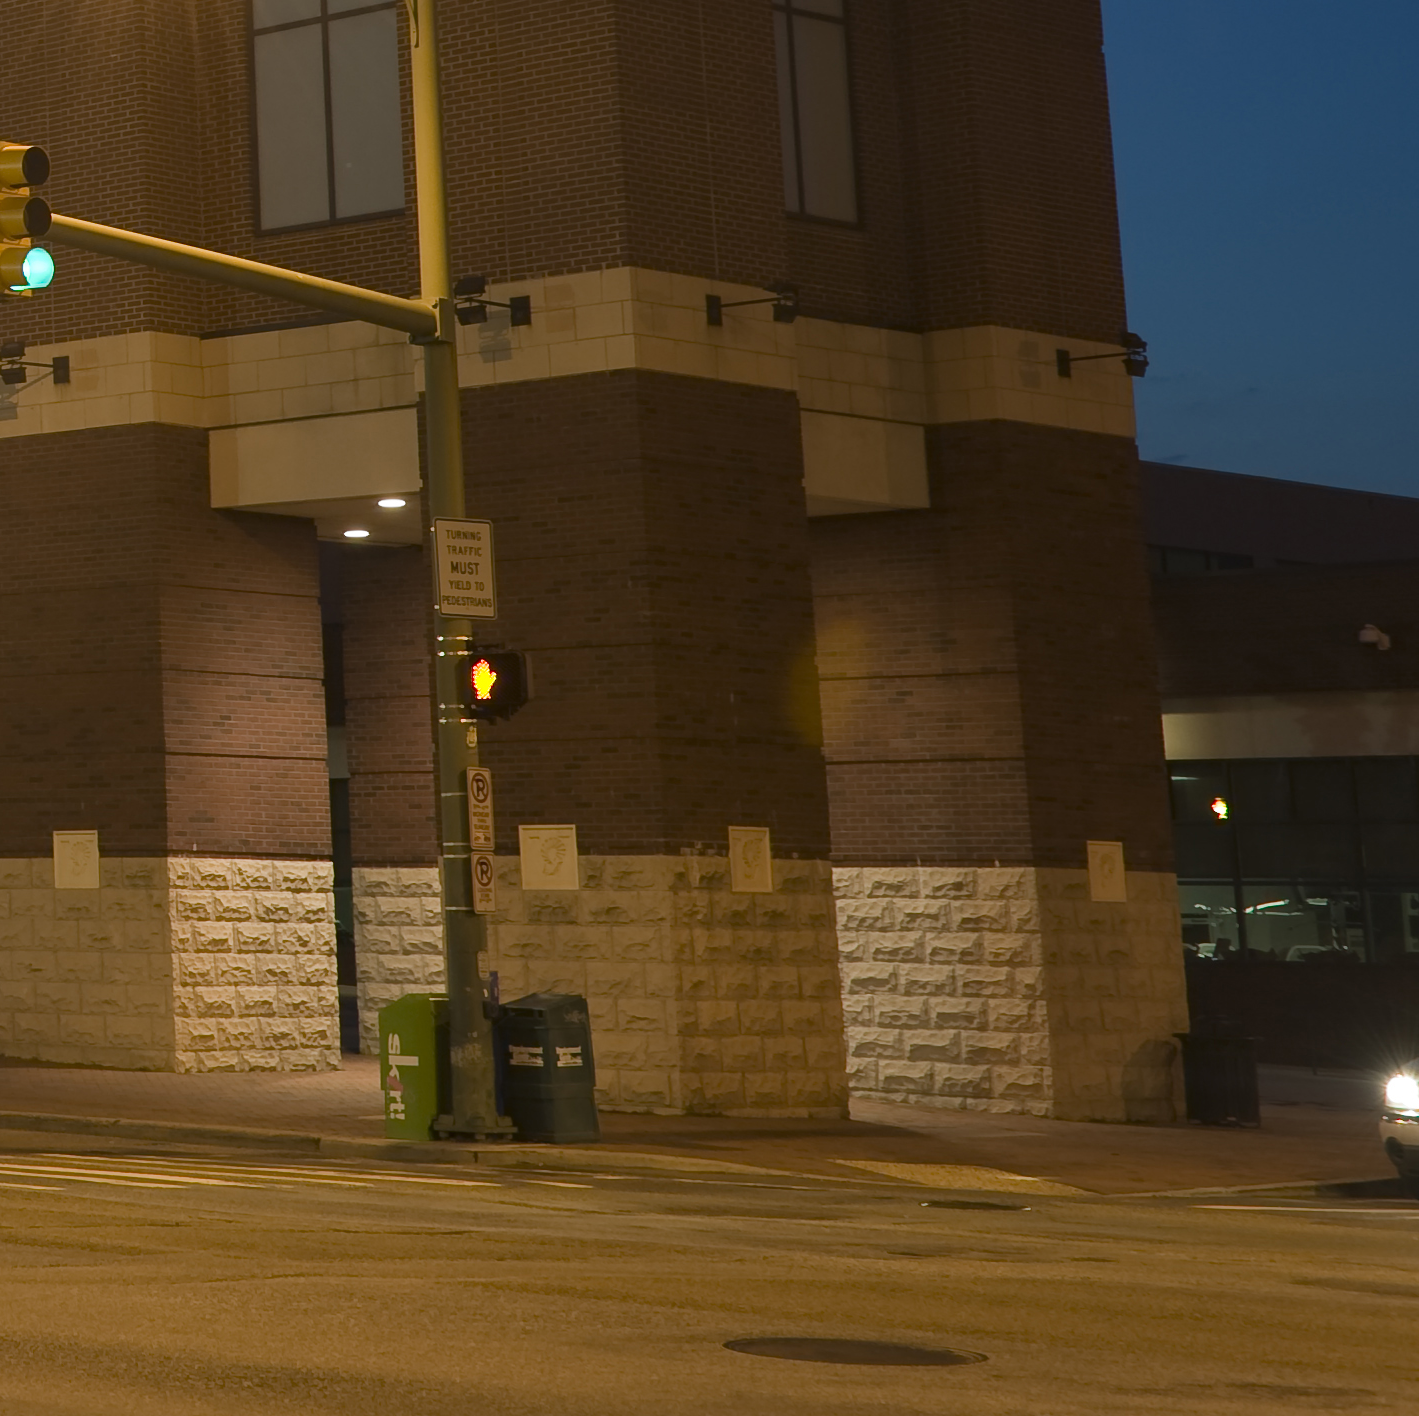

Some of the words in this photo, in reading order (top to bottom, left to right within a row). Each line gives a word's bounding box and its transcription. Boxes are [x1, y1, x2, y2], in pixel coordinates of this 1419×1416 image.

[445, 529, 482, 541] TURNING
[446, 545, 482, 557] TRAFFIC
[450, 560, 480, 575] MUST
[448, 579, 472, 591] YIELD
[474, 581, 485, 592] TO
[442, 594, 493, 608] PEDESTRIANS
